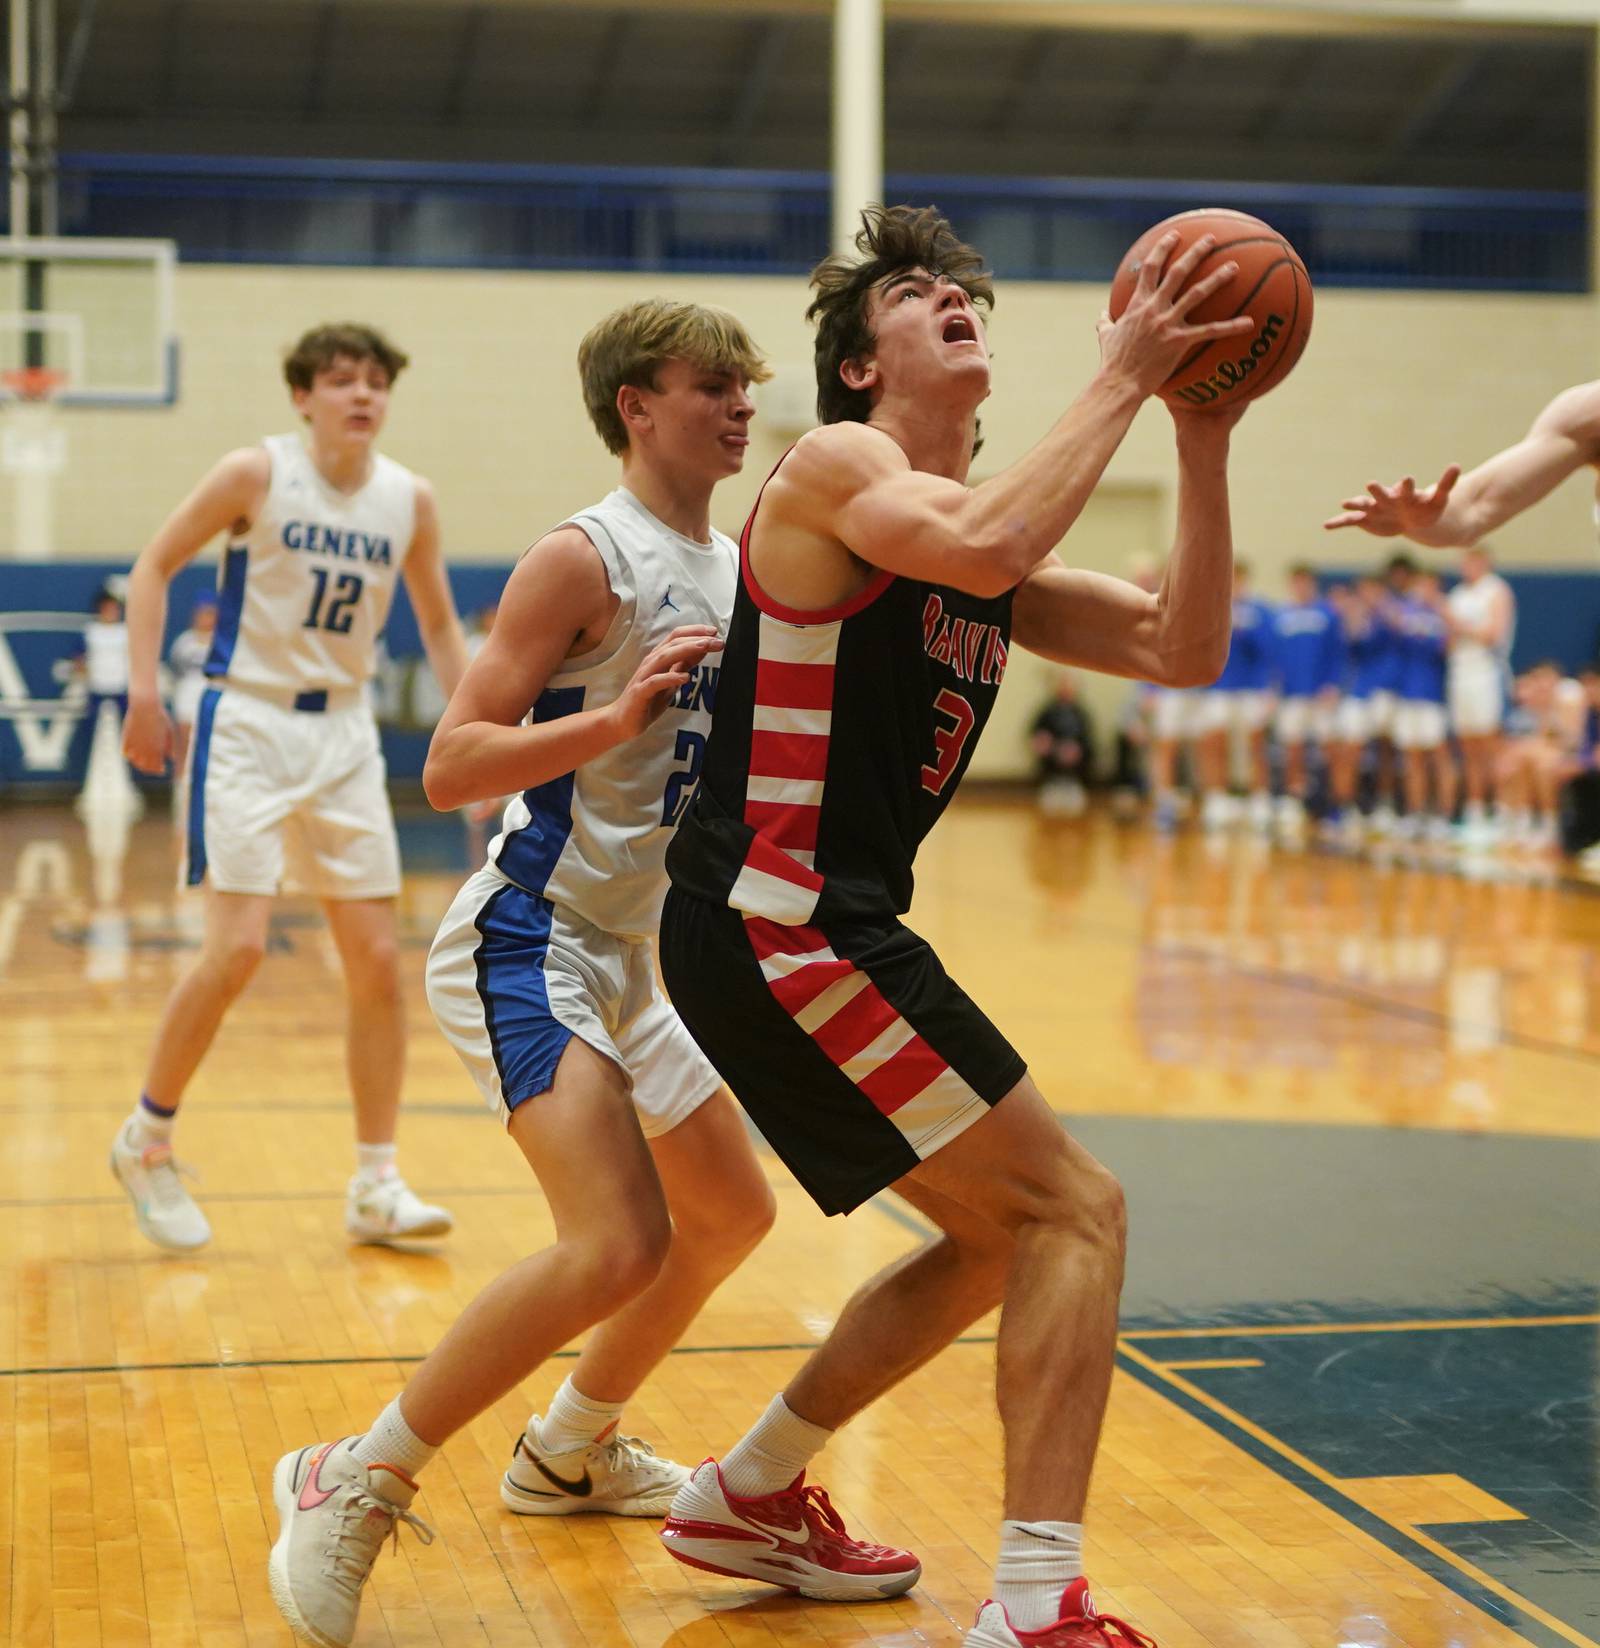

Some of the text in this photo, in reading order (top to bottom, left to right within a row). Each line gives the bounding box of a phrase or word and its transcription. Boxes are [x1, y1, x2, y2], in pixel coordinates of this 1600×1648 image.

[1173, 312, 1286, 405] Wilson
[281, 520, 392, 567] GENEVA
[302, 566, 364, 634] 12
[921, 687, 975, 796] 3
